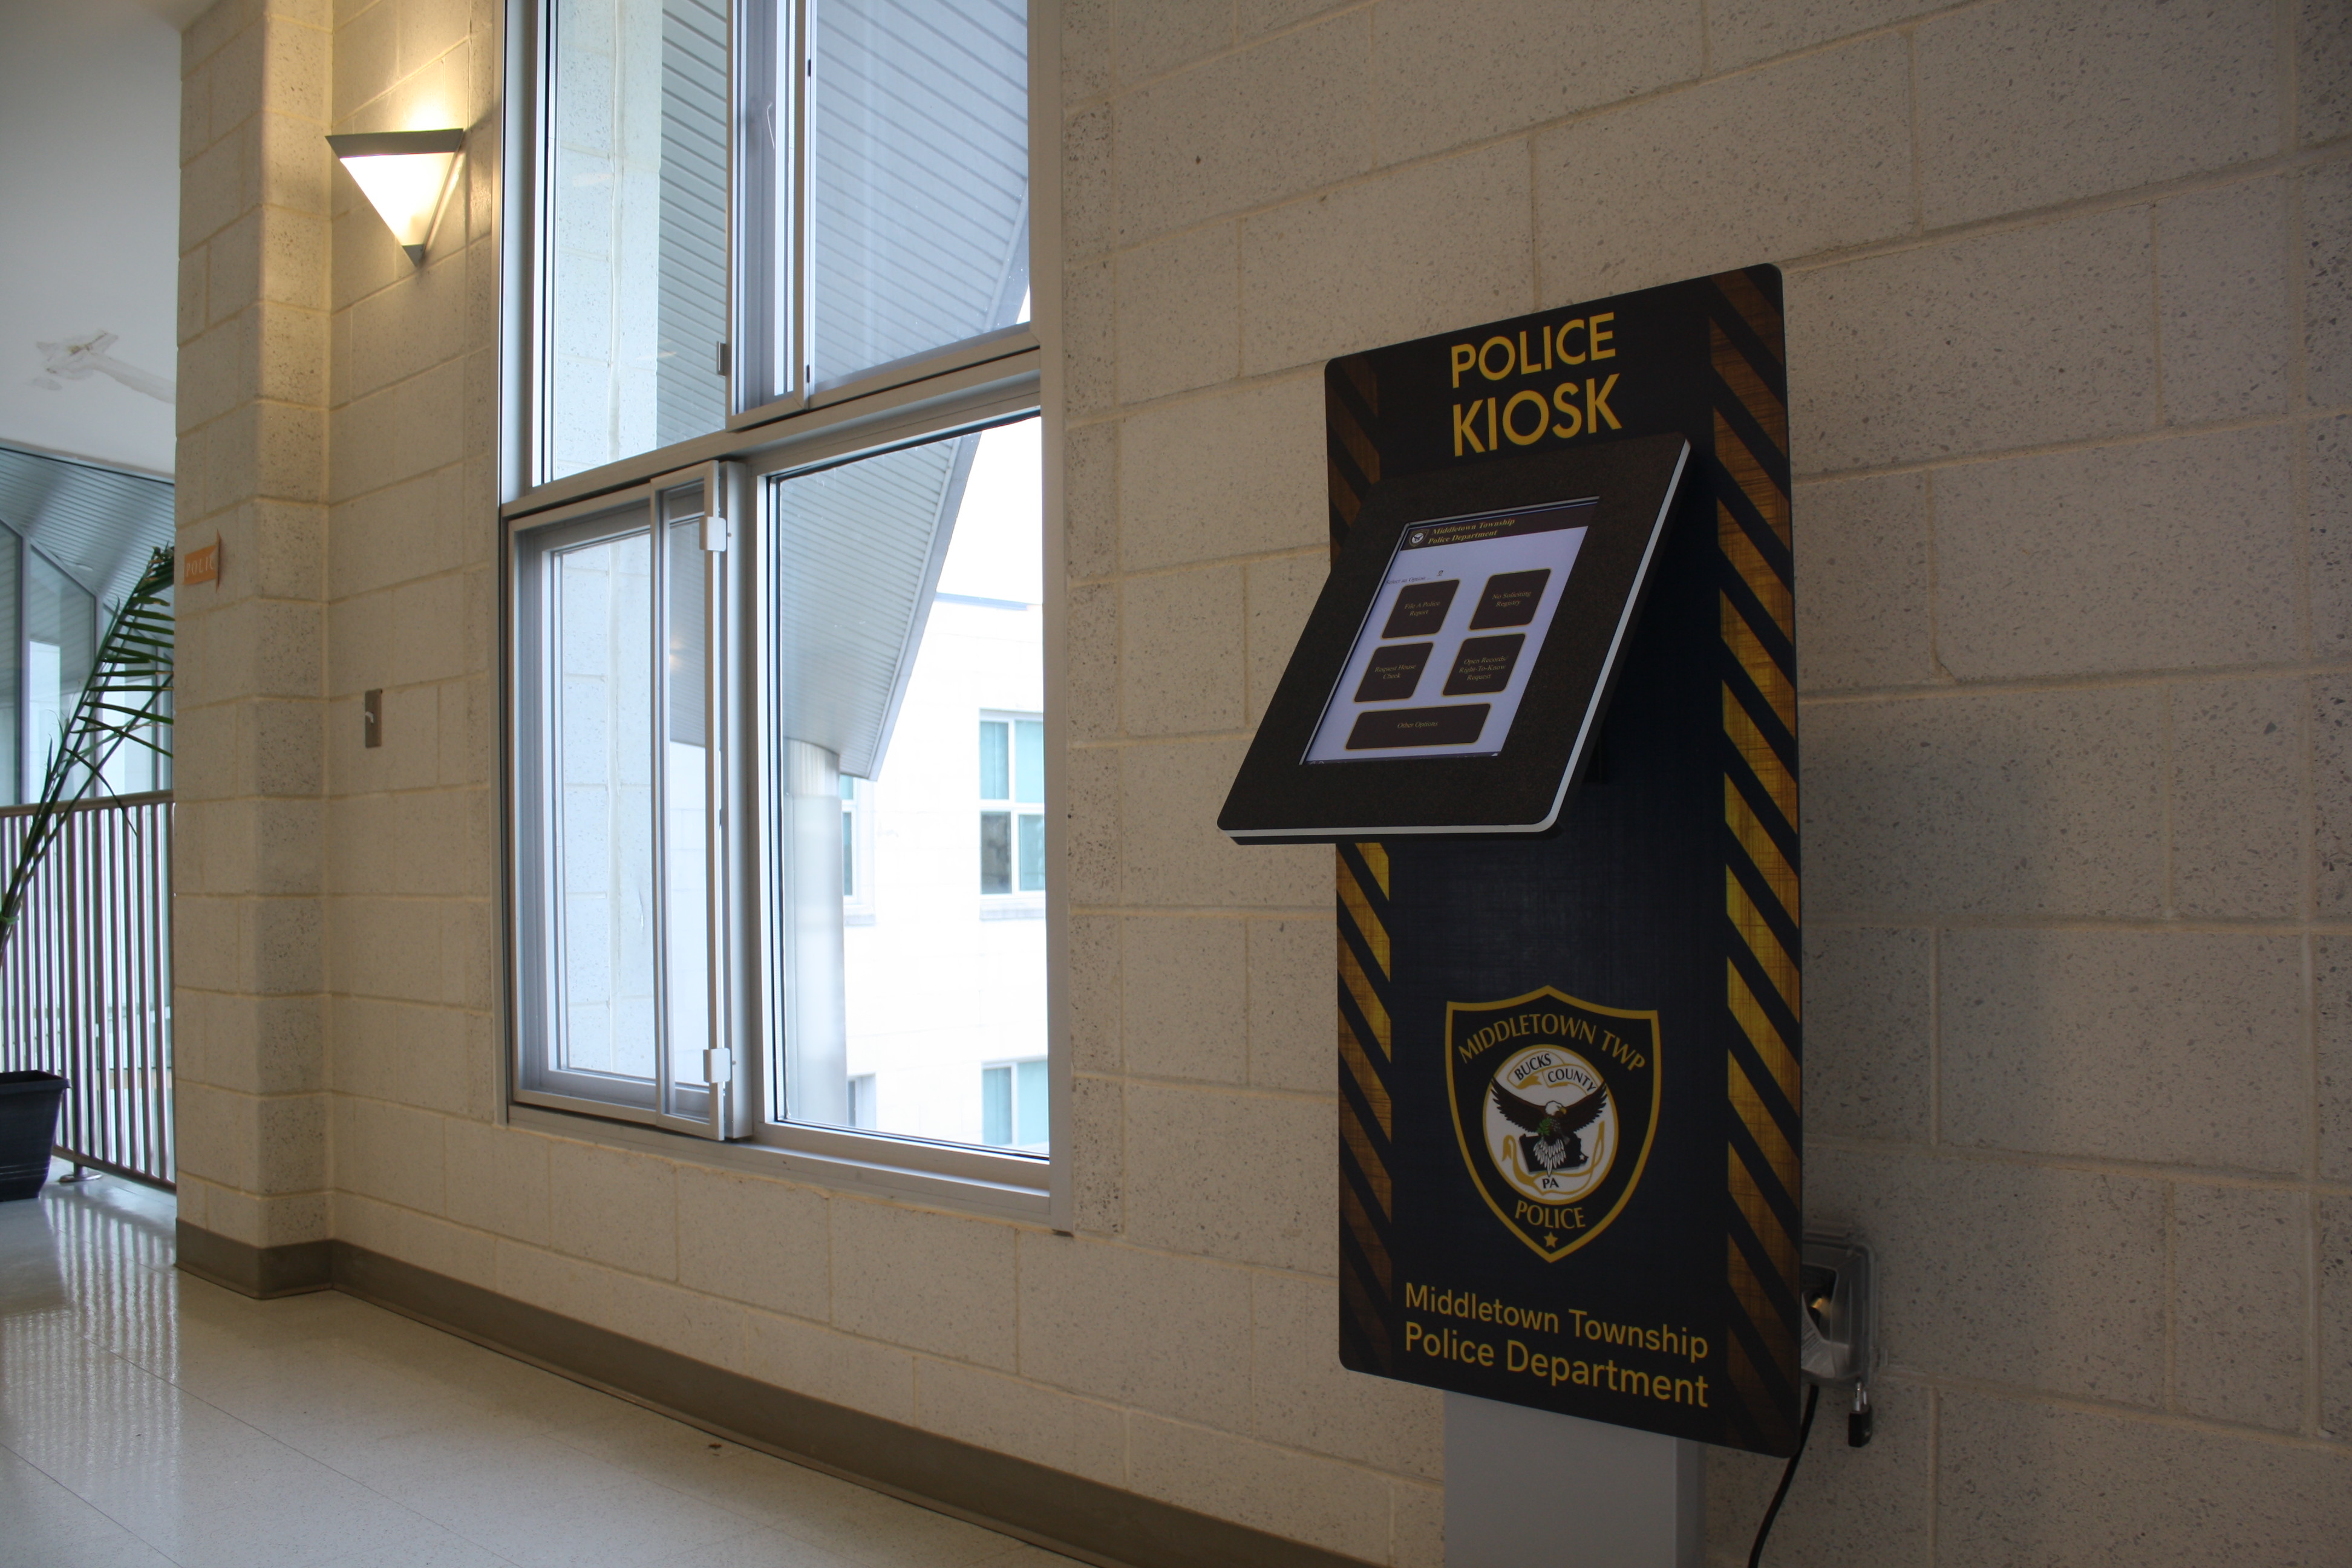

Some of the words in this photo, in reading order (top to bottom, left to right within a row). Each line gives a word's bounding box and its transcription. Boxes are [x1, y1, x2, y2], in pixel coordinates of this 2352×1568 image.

[1451, 312, 1616, 388] POLICE
[1452, 373, 1622, 457] KIOSK
[1432, 524, 1476, 535] Middletown
[1479, 518, 1515, 529] Township
[1452, 530, 1498, 541] Department
[186, 556, 214, 578] POLIC
[1458, 1013, 1597, 1064] MIDDLETOWN
[1603, 1030, 1646, 1071] TWP
[1514, 1053, 1552, 1081] BUCKS
[1547, 1068, 1597, 1093] COUNTY
[1542, 1178, 1560, 1189] PA
[1515, 1200, 1586, 1229] POLICE
[1405, 1282, 1559, 1334] Middletown
[1569, 1308, 1708, 1364] Township
[1406, 1321, 1494, 1367] Police
[1507, 1339, 1709, 1408] Department
